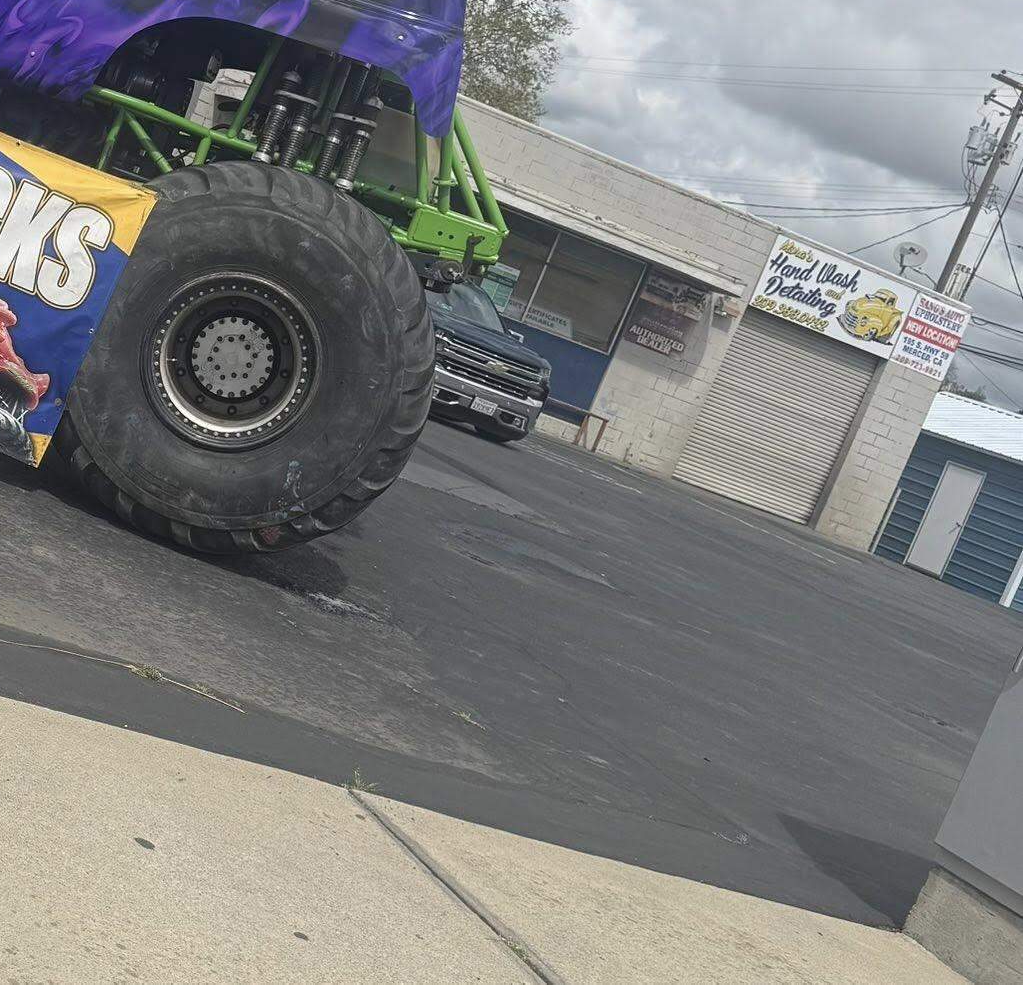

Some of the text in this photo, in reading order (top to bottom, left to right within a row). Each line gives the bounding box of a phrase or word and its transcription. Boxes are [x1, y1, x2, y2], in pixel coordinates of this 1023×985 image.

[769, 252, 861, 293] Hand Wash
[764, 275, 837, 318] Detailing
[915, 307, 963, 333] UPHOLSTERY
[946, 309, 965, 323] AUTO
[629, 324, 684, 352] AUTHORIZED
[905, 320, 924, 335] NEW
[636, 334, 672, 355] DEALER
[923, 344, 940, 356] HWY
[933, 357, 943, 367] CA
